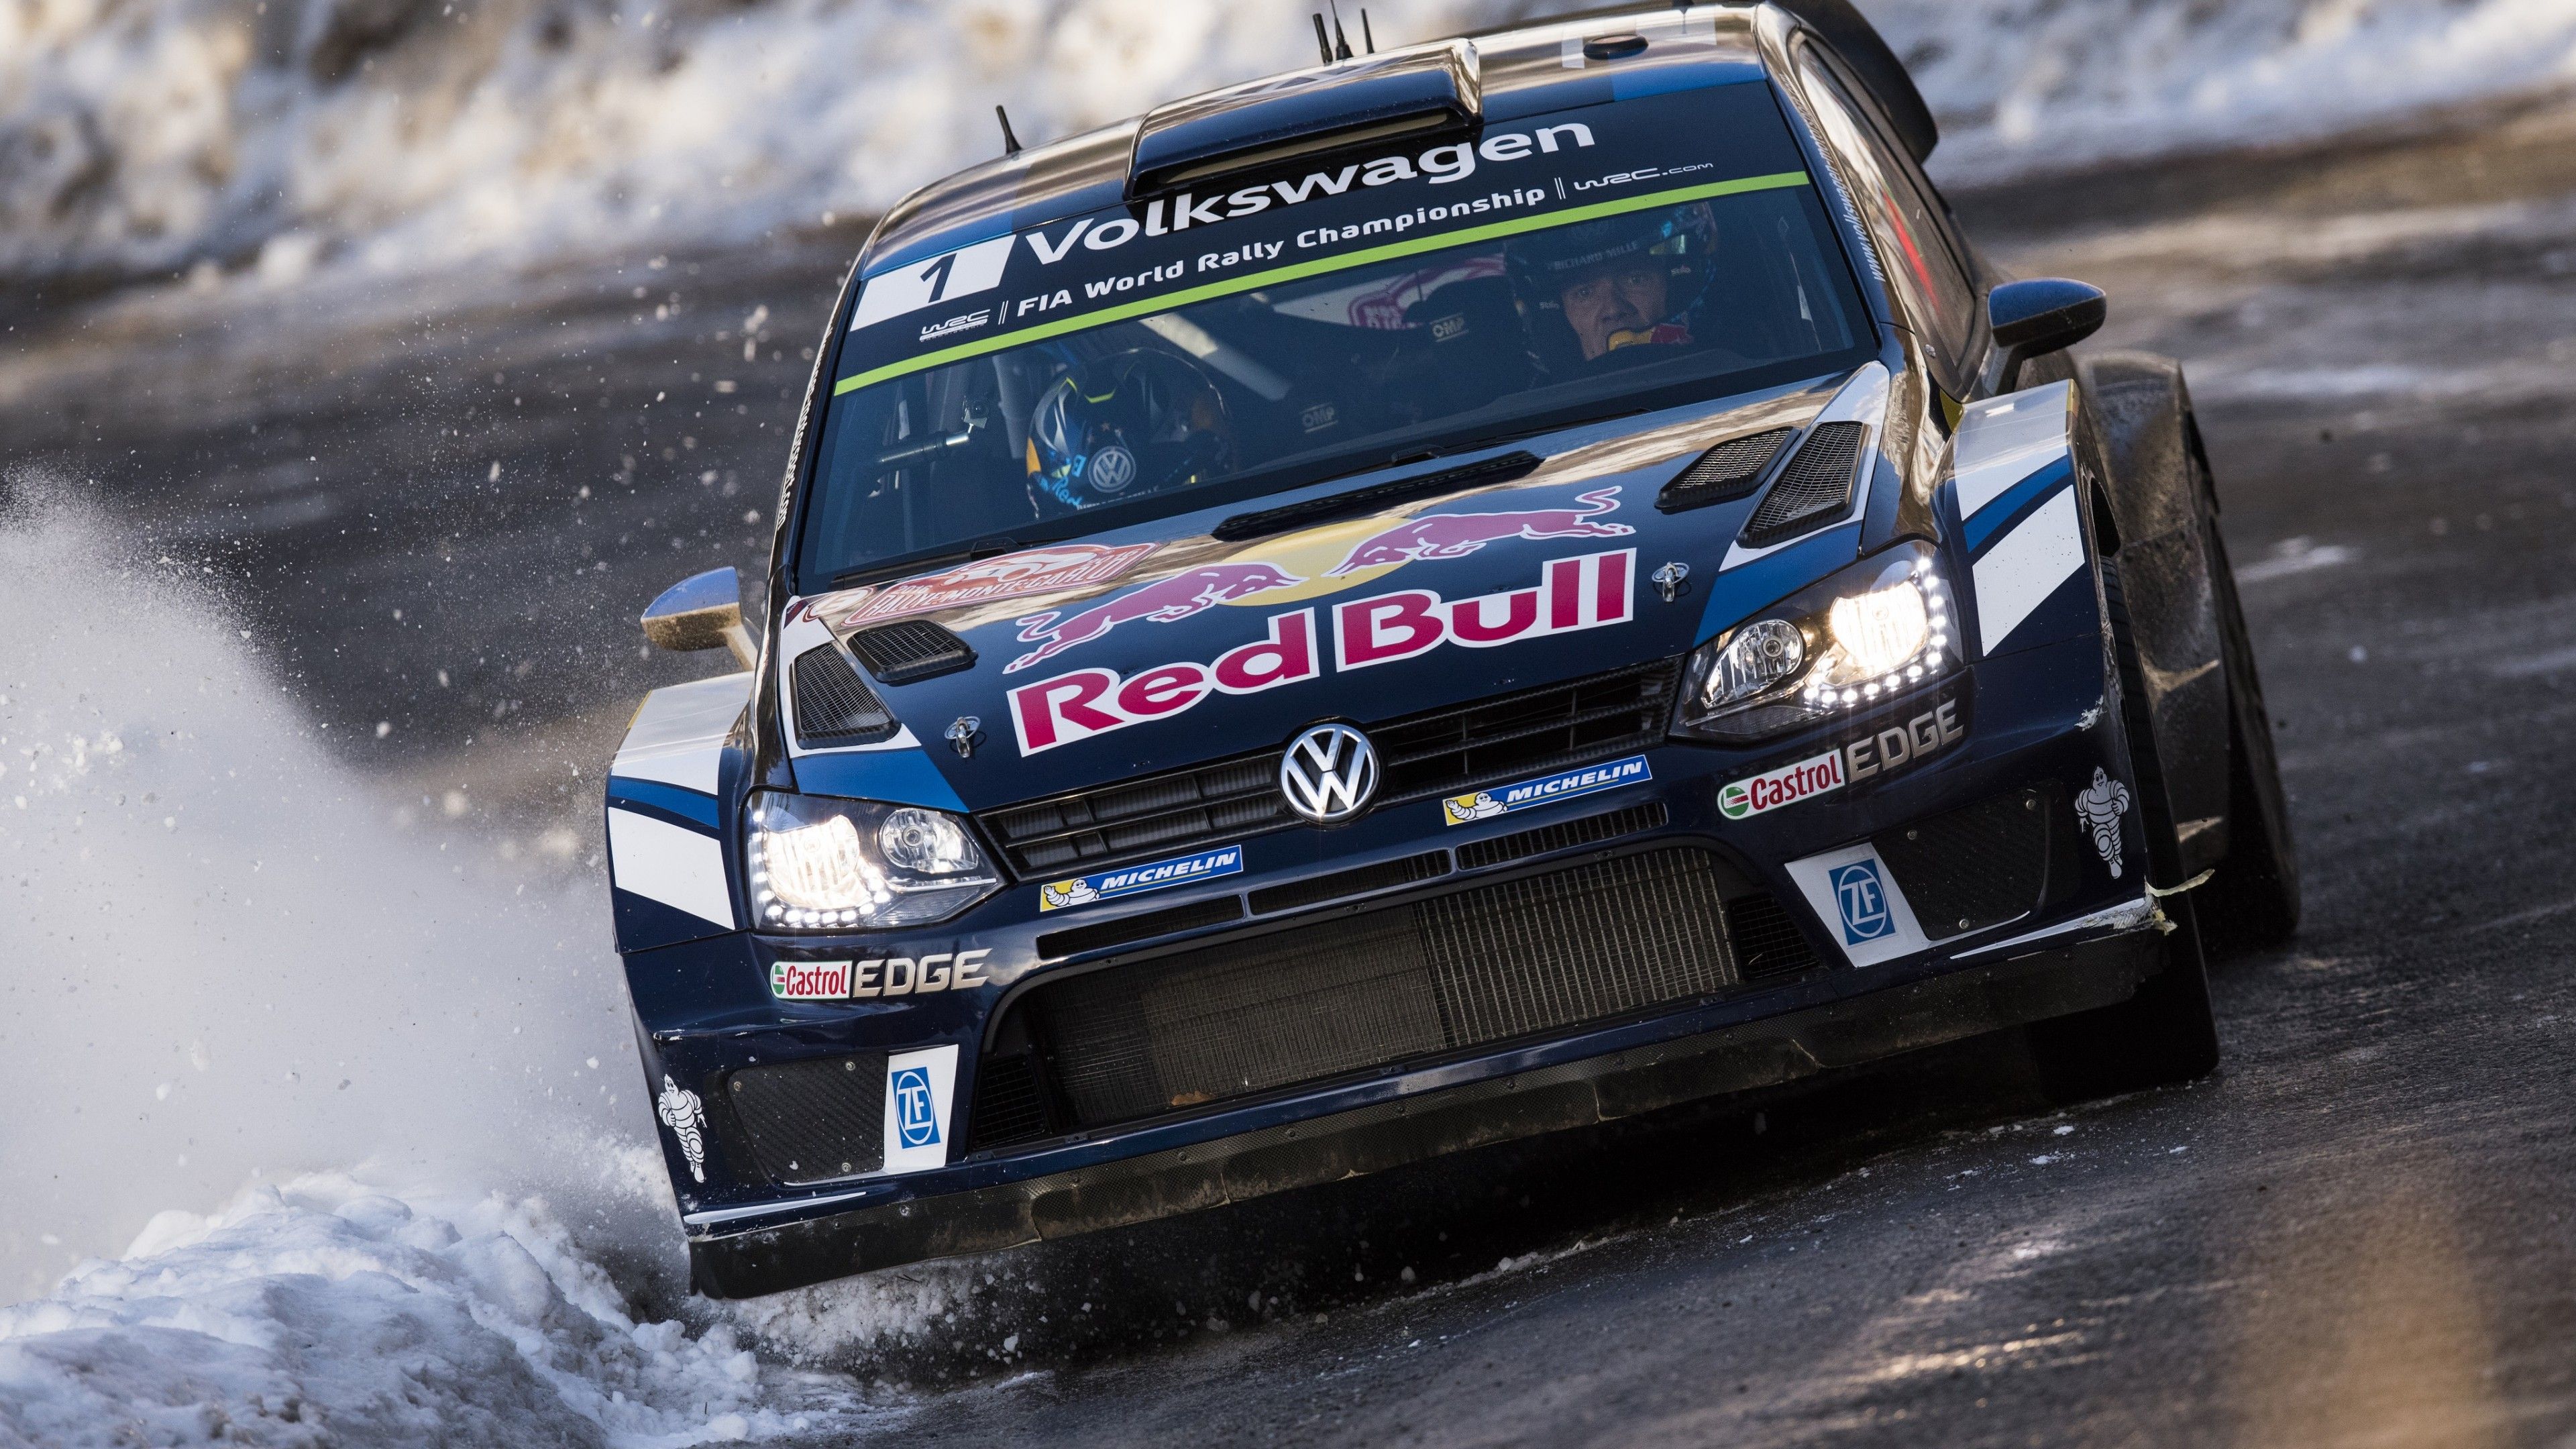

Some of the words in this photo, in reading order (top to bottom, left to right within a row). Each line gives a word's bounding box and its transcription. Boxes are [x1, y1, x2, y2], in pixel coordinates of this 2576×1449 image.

[1026, 123, 1595, 264] Volkswagen
[919, 252, 957, 304] 1
[921, 309, 991, 335] WRC
[1018, 289, 1073, 317] FIA
[1085, 260, 1183, 299] World
[1197, 240, 1285, 272] Rally
[1297, 188, 1546, 248] Championship
[1432, 316, 1466, 338] OMP
[1016, 610, 1313, 750] Red
[1342, 551, 1629, 666] Bull
[1281, 723, 1376, 818] VW
[1750, 754, 1841, 810] Castrol
[1846, 698, 1964, 784] EDGE
[1506, 761, 1642, 803] MICHELIN
[1100, 851, 1237, 890] MICHELIN
[1840, 877, 1885, 926] ZF
[786, 965, 847, 996] Castrol
[853, 948, 994, 998] EDGE
[898, 1085, 932, 1130] ZF
